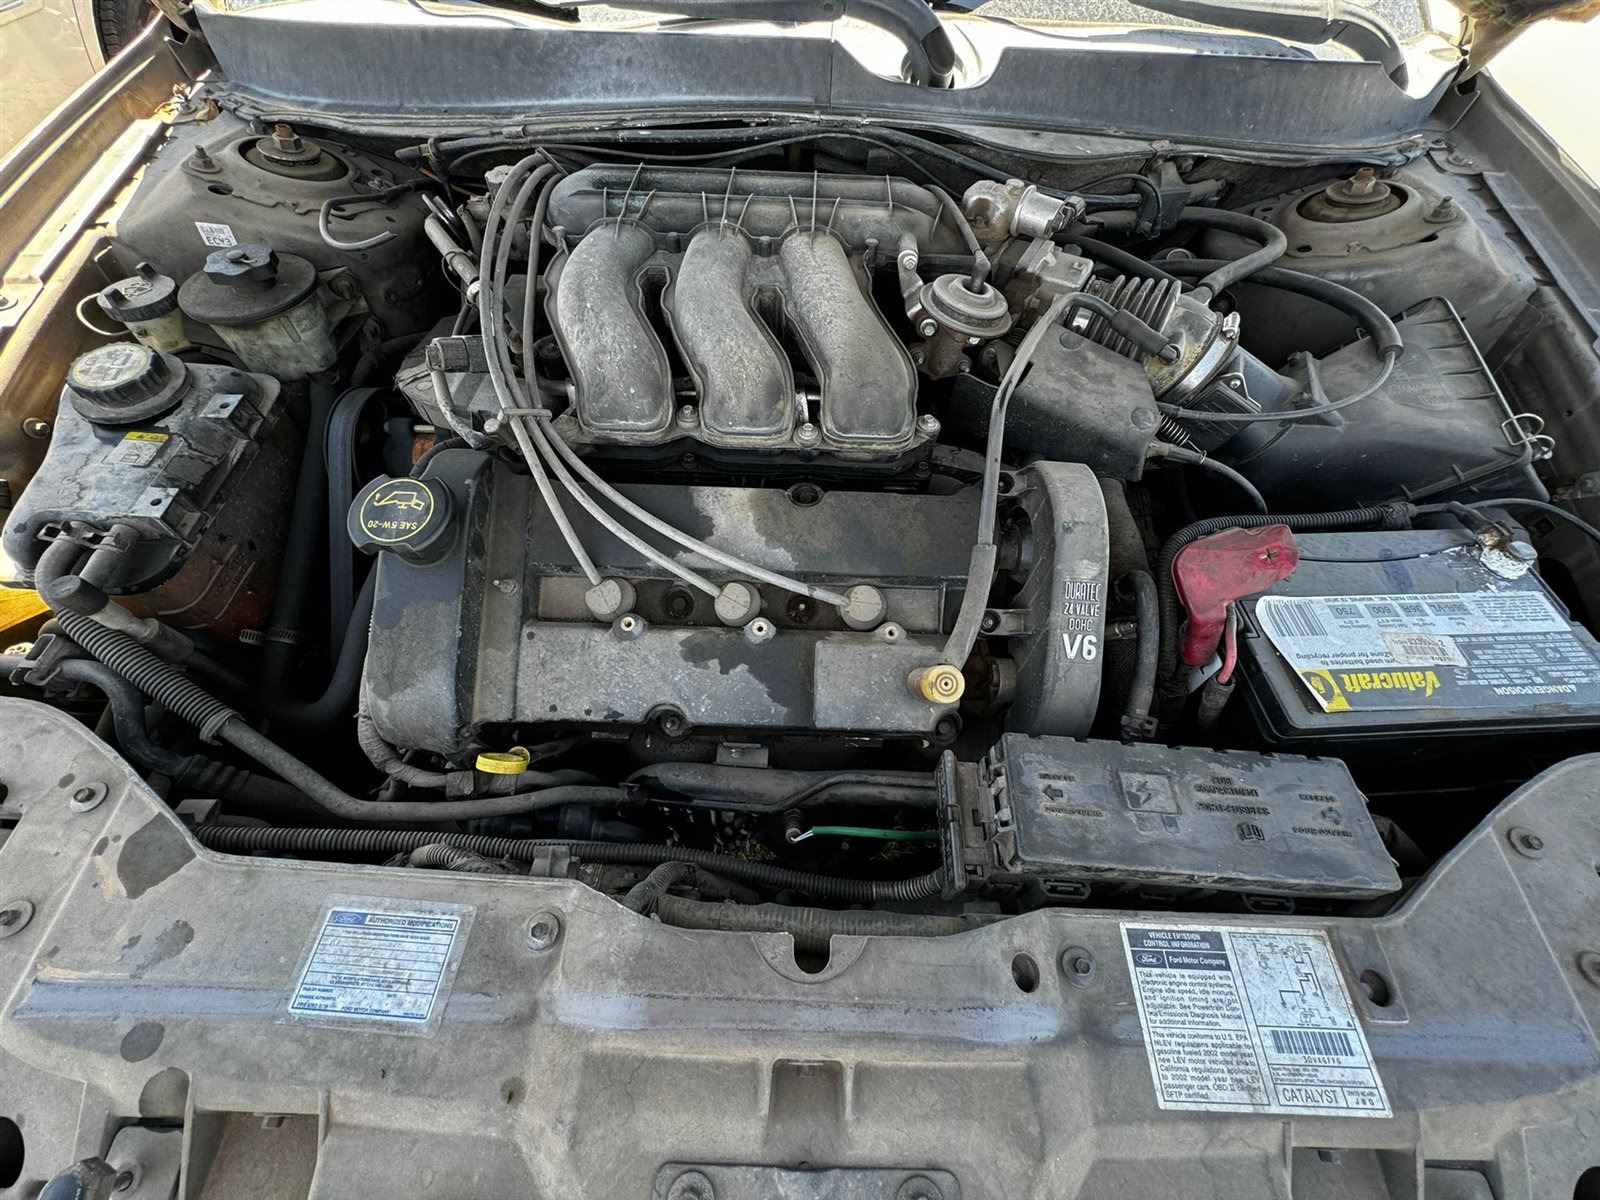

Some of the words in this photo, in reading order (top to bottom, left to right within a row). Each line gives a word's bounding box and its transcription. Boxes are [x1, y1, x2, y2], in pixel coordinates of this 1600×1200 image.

[368, 520, 398, 528] 5W-20
[399, 522, 418, 530] SAE
[1065, 582, 1101, 601] DURATEC
[1064, 602, 1074, 614] 24
[1076, 603, 1100, 616] VALVE
[1402, 604, 1422, 612] 36R
[1069, 618, 1092, 631] DOHC
[1062, 633, 1098, 660] V6
[1340, 670, 1440, 697] Valucraft
[368, 916, 406, 926] AUTHORIZED
[407, 919, 454, 930] MODIFICATIONS
[1148, 932, 1172, 940] VEHICLE
[1143, 940, 1171, 948] CONTROL
[1171, 940, 1210, 949] INFORMATION
[1169, 956, 1182, 964] Ford
[1200, 957, 1226, 966] Company
[1188, 972, 1216, 980] equipped
[1142, 986, 1162, 994] Engine
[1178, 988, 1198, 996] speed,
[1160, 995, 1184, 1003] ignition
[1188, 996, 1208, 1004] timing
[1146, 1002, 1176, 1010] adjustable.
[1192, 1003, 1224, 1011] Powertrain
[1190, 1011, 1219, 1020] Diagnosis
[1175, 1041, 1209, 1049] regulations
[1211, 1042, 1242, 1050] applicable
[1191, 1066, 1225, 1074] regulations
[1227, 1067, 1258, 1075] applicable
[1282, 1088, 1338, 1104] CATALYST
